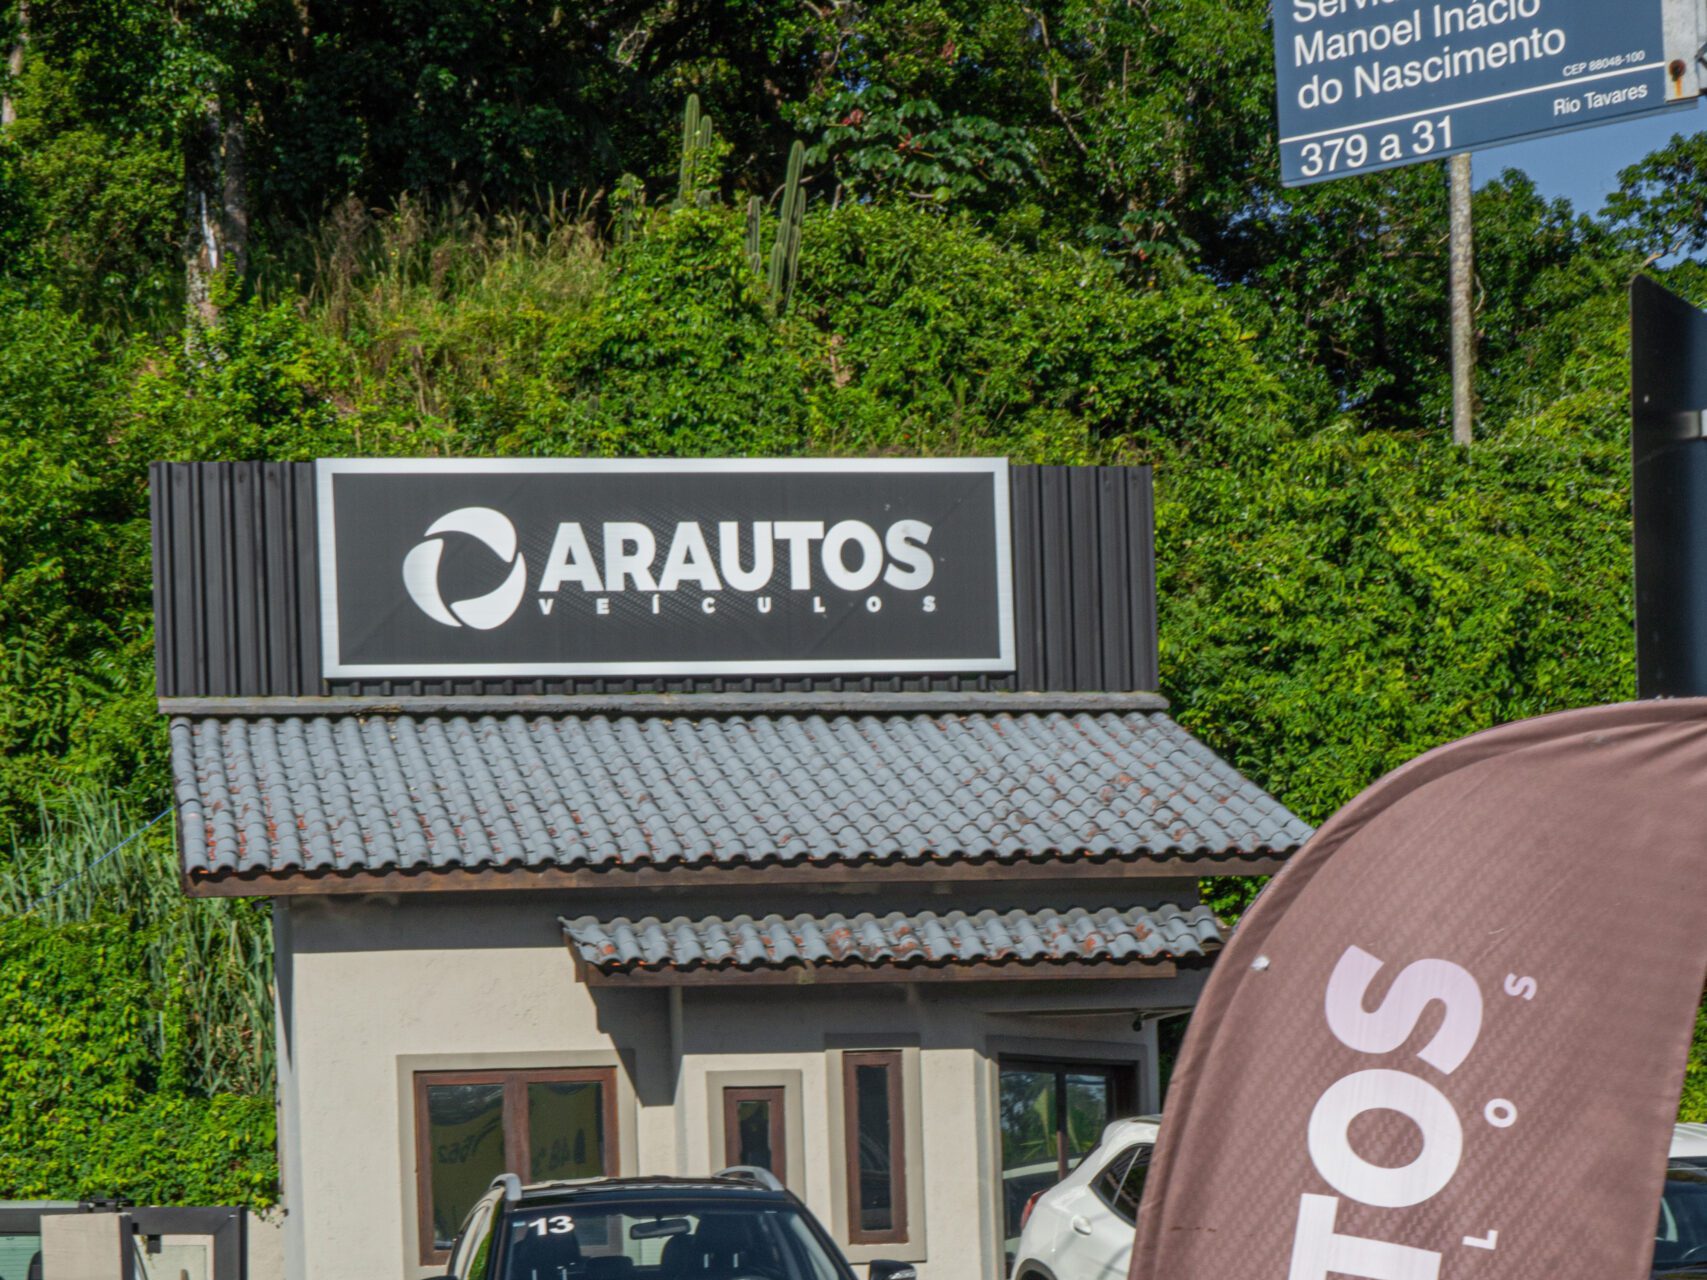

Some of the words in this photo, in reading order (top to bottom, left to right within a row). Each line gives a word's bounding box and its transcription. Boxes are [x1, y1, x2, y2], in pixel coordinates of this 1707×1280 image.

[1294, 9, 1422, 67] Manoel
[1433, 0, 1541, 38] Inácio
[1297, 74, 1343, 109] do
[1354, 27, 1566, 98] Nascimento
[1562, 61, 1588, 77] CEP
[1553, 97, 1582, 117] Rio
[1583, 83, 1648, 110] Tavares
[1300, 133, 1368, 177] 379
[1379, 133, 1403, 161] a
[1412, 115, 1452, 154] 31
[538, 519, 934, 593] ARAUTOS
[538, 594, 937, 616] VEÍCULOS
[528, 1215, 575, 1236] 13
